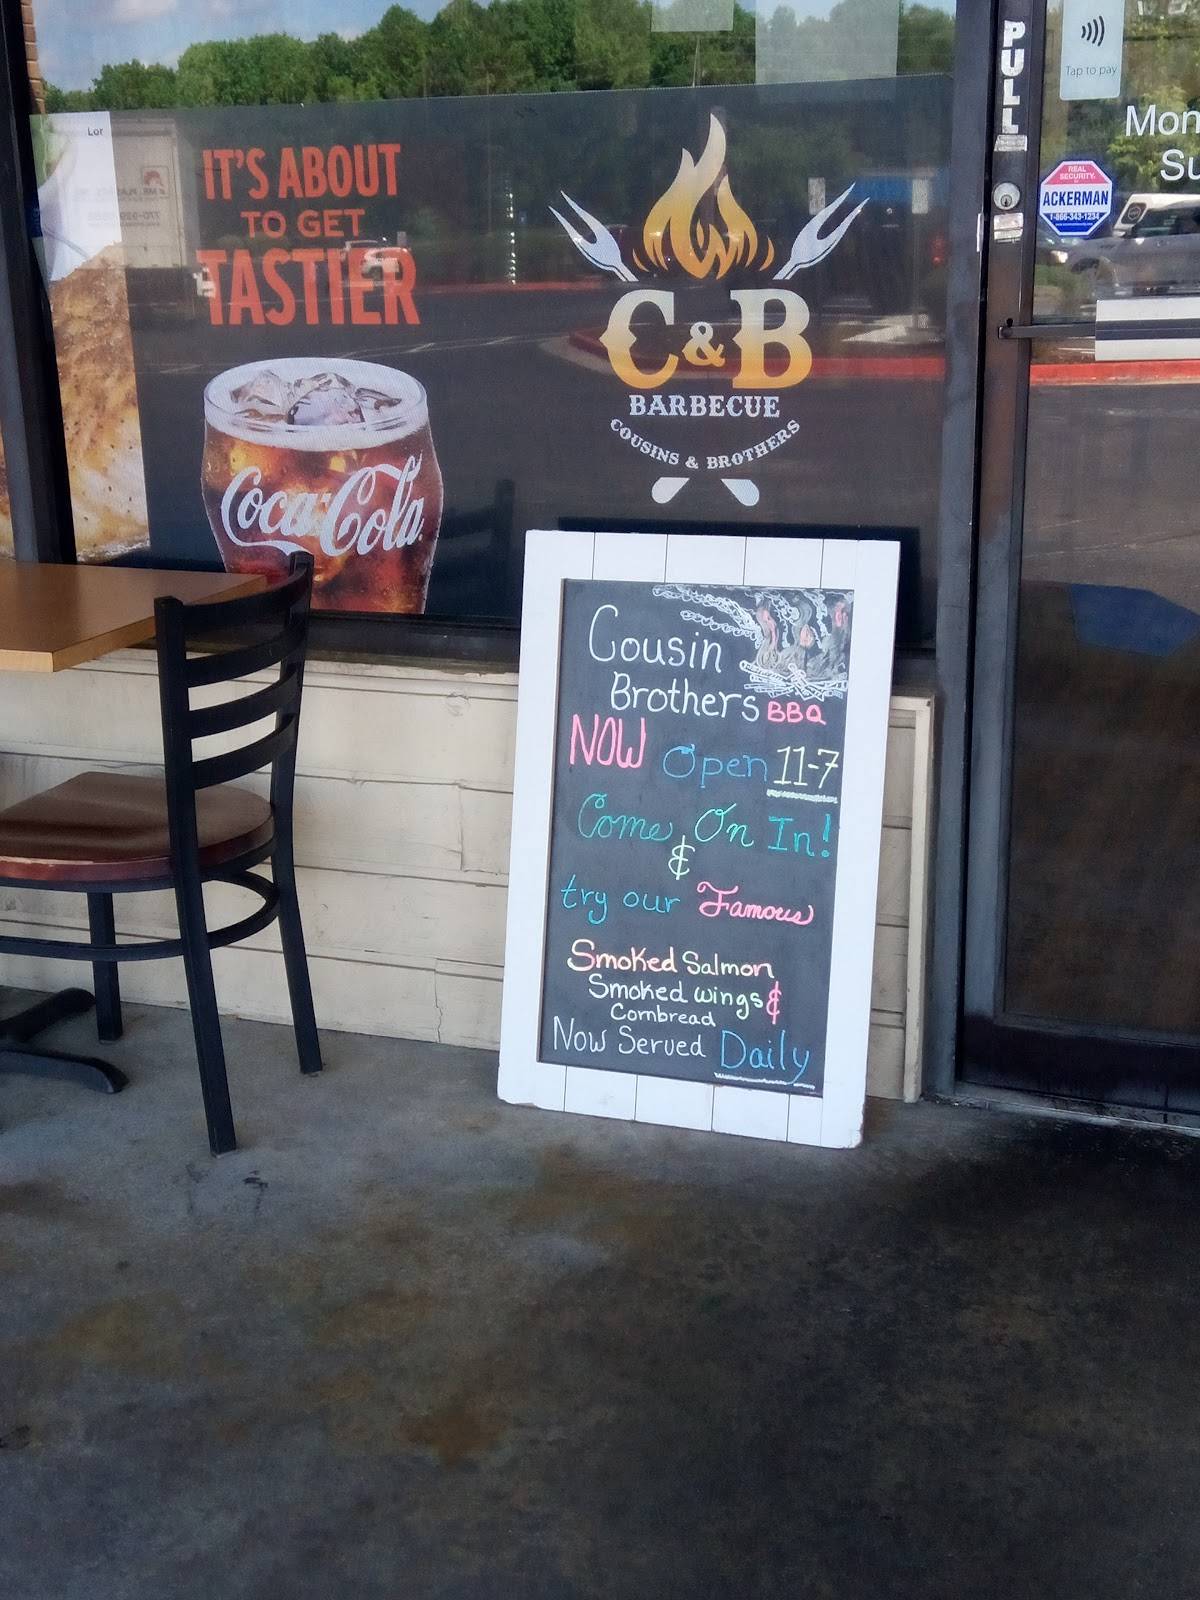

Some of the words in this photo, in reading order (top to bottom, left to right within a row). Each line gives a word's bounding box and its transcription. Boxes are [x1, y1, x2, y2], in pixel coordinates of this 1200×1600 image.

[1000, 20, 1026, 134] PULL
[1066, 66, 1082, 76] Tap
[1086, 66, 1096, 75] to
[1099, 65, 1118, 76] pay
[202, 148, 270, 200] IT'S
[278, 143, 401, 199] ABOUT
[1067, 165, 1087, 173] REAL
[240, 210, 288, 239] TO
[297, 207, 365, 238] GET
[1042, 190, 1109, 207] ACKERMAN
[196, 246, 421, 326] TASTIER
[628, 394, 781, 418] BARBECUE
[610, 418, 680, 466] COUSINS
[685, 455, 700, 470] &
[706, 419, 801, 470] BROTHERS
[588, 603, 723, 673] Cousin
[610, 670, 761, 722] Brothers
[766, 700, 827, 725] BBQ
[569, 713, 648, 769] NOW
[662, 743, 768, 788] Open
[772, 745, 840, 789] 11-7
[577, 793, 674, 840] Come
[694, 803, 755, 847] On
[767, 813, 832, 858] In!
[560, 874, 609, 926] try
[622, 891, 681, 914] our
[696, 880, 815, 926] Famous
[682, 951, 775, 979] Salmon
[588, 973, 689, 1004] Smoked
[693, 985, 764, 1020] wings
[609, 1002, 716, 1028] Cornbread
[552, 1015, 608, 1053] Now
[617, 1025, 707, 1058] Served
[719, 1029, 810, 1085] Daily
